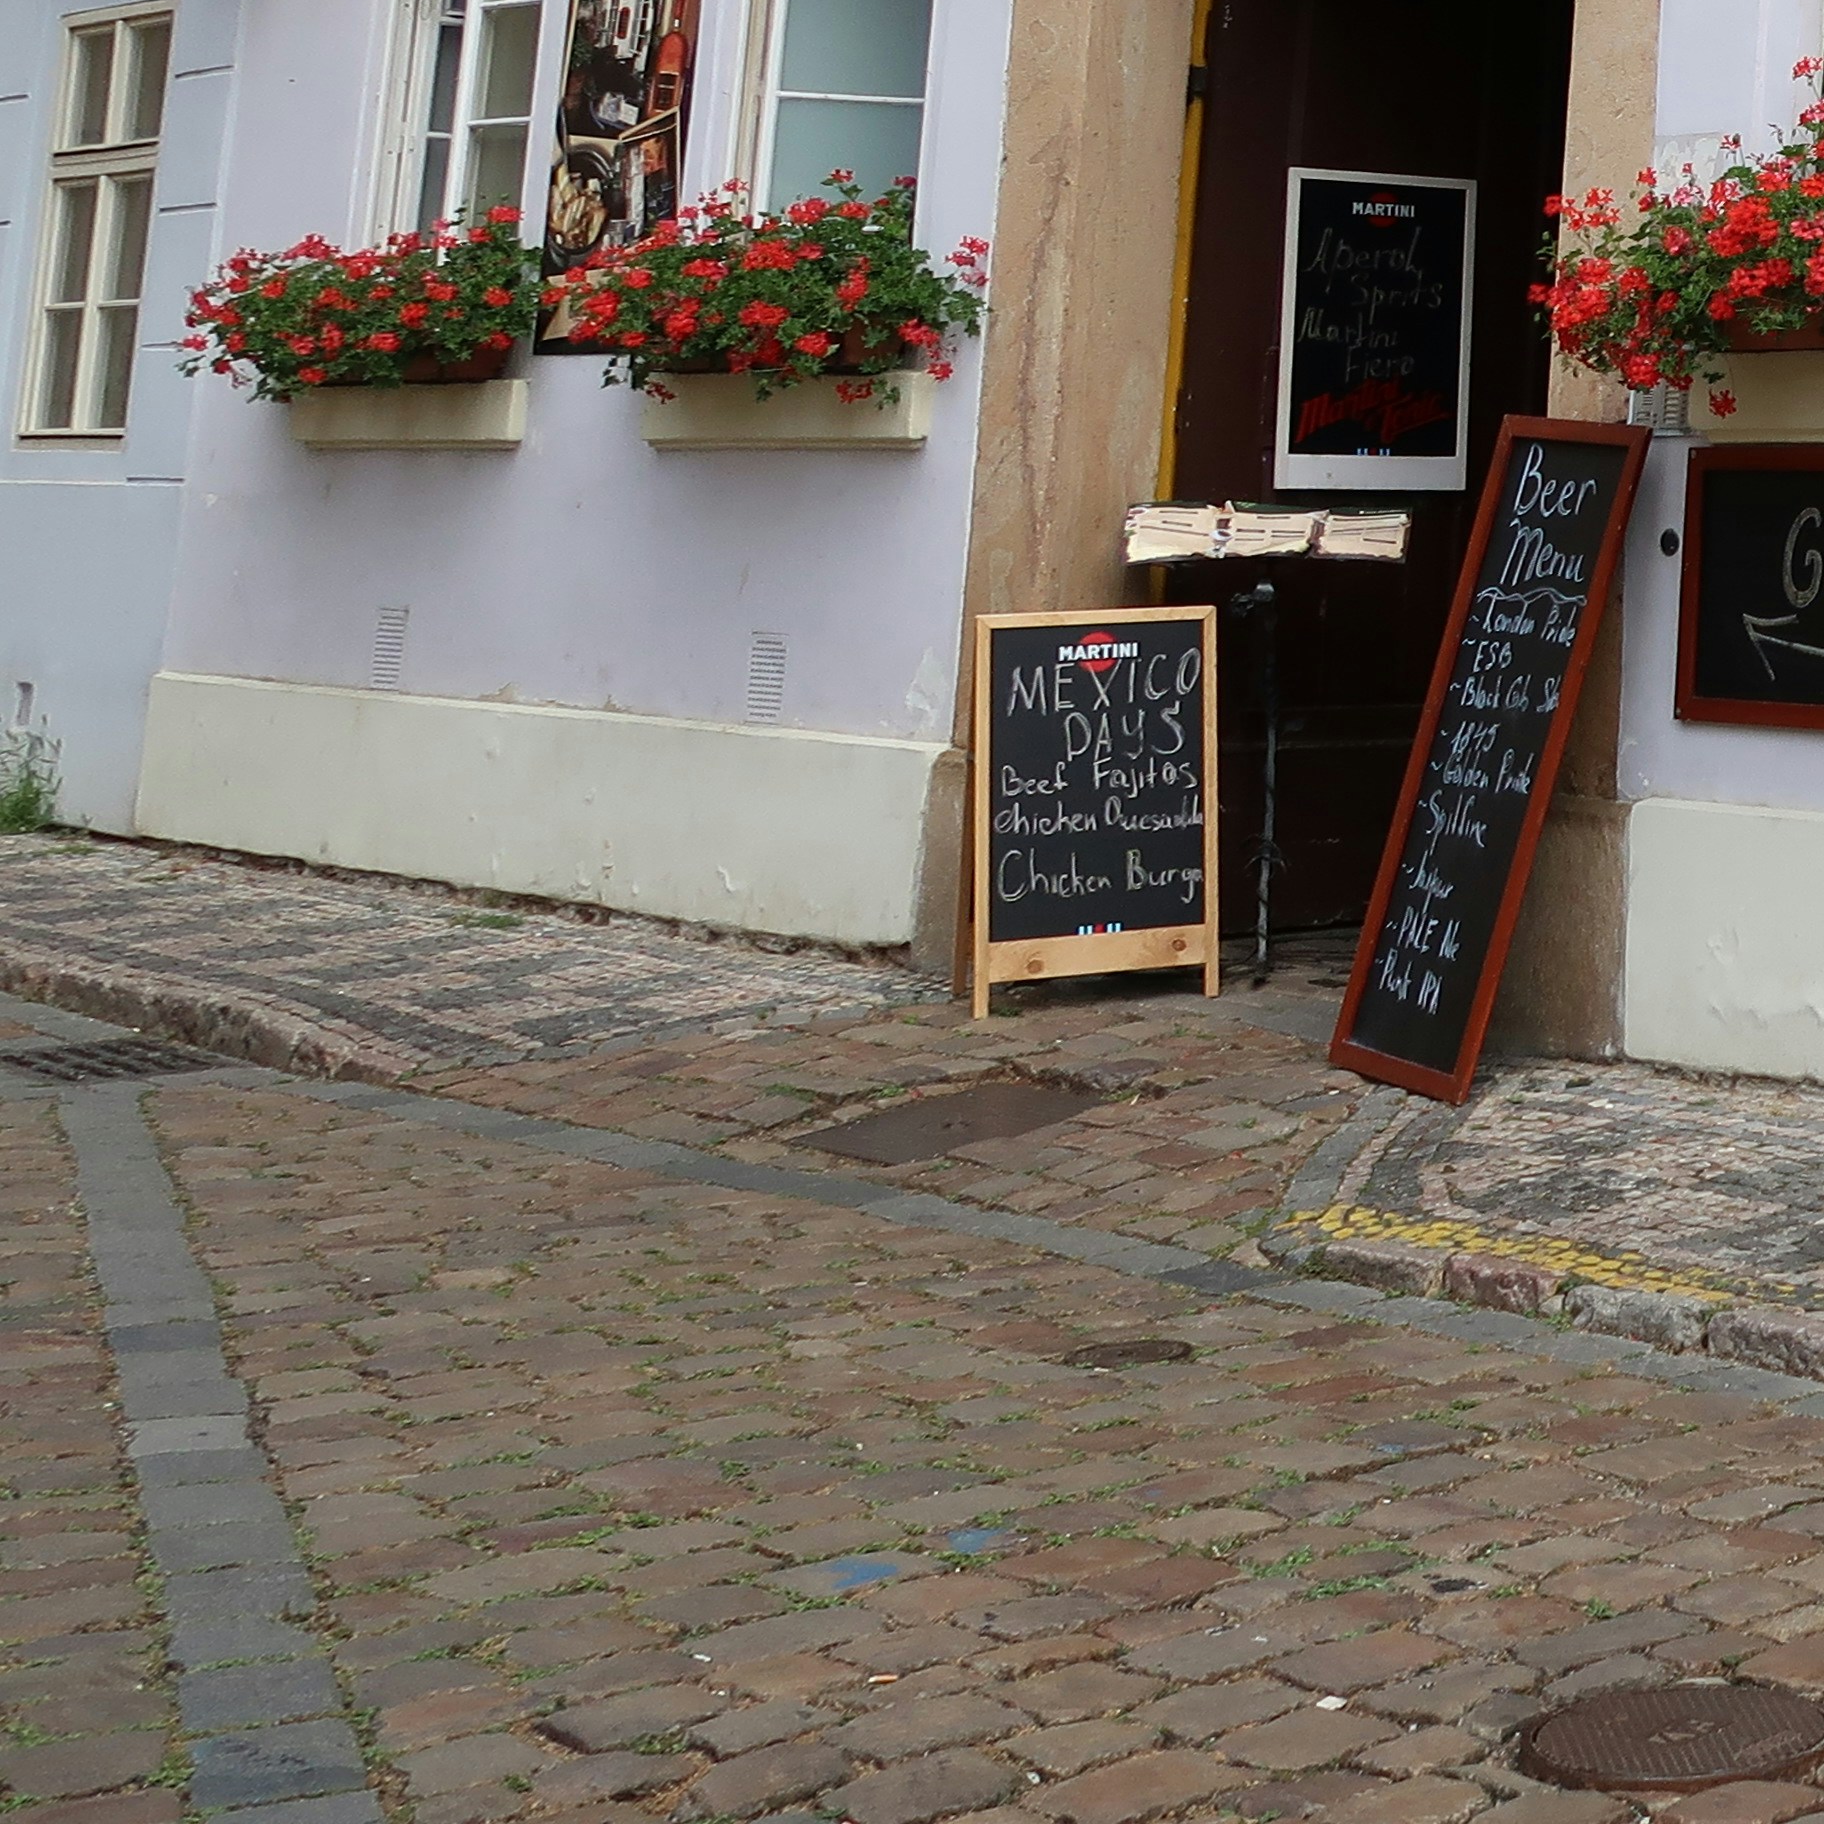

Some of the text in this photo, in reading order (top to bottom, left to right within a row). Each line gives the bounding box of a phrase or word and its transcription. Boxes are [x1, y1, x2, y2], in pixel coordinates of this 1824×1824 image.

[1352, 201, 1416, 218] MARTINI
[1514, 442, 1597, 518] Beer
[1500, 517, 1584, 586] Menu
[1059, 642, 1138, 661] MARTINI
[1007, 647, 1200, 717] MEXICO
[1064, 700, 1186, 762] DAYS
[1002, 761, 1068, 796] Beef
[995, 800, 1097, 835] Chicken
[999, 848, 1112, 902] Chicken
